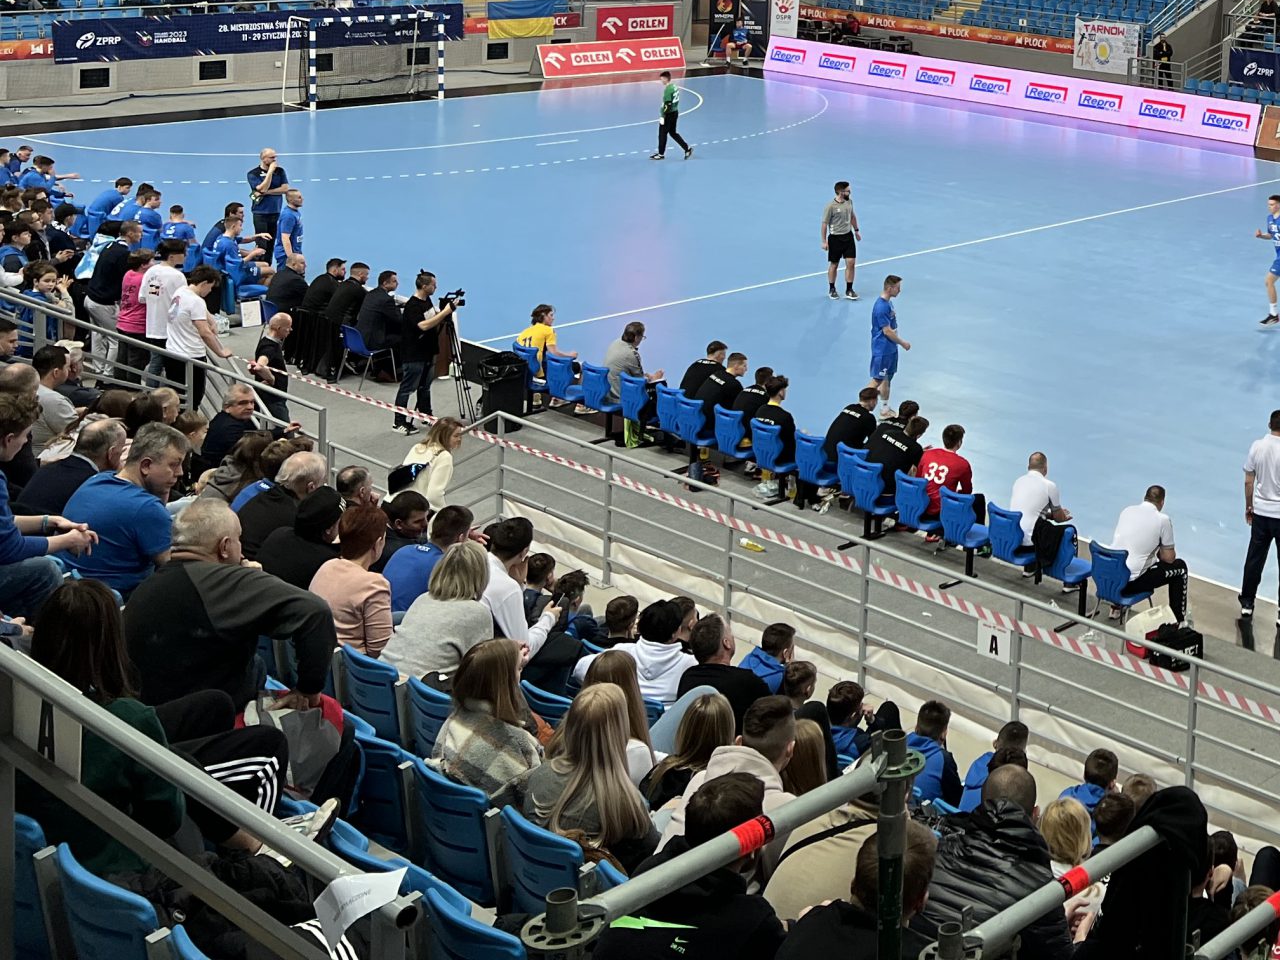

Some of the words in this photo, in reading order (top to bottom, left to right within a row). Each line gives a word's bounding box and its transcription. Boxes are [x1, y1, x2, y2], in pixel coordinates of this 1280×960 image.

[218, 24, 229, 33] 28.
[230, 21, 274, 32] MISTRZOSTWA
[275, 20, 297, 29] ŚWITA
[630, 19, 666, 29] ORLEN
[96, 36, 121, 46] ZPRP
[574, 53, 610, 64] ORLEN
[643, 48, 678, 59] ORLEN
[774, 50, 800, 63] Repro
[823, 57, 850, 69] Repro
[872, 64, 901, 76] Repro
[1257, 67, 1275, 78] ZPRP
[920, 71, 950, 84] Repro
[973, 78, 1005, 92] Repro
[1029, 87, 1061, 102] Repro
[1082, 94, 1116, 109] Repro
[1144, 104, 1178, 119] Repro
[1207, 113, 1243, 129] Repro
[924, 461, 949, 485] 33
[989, 634, 999, 656] A
